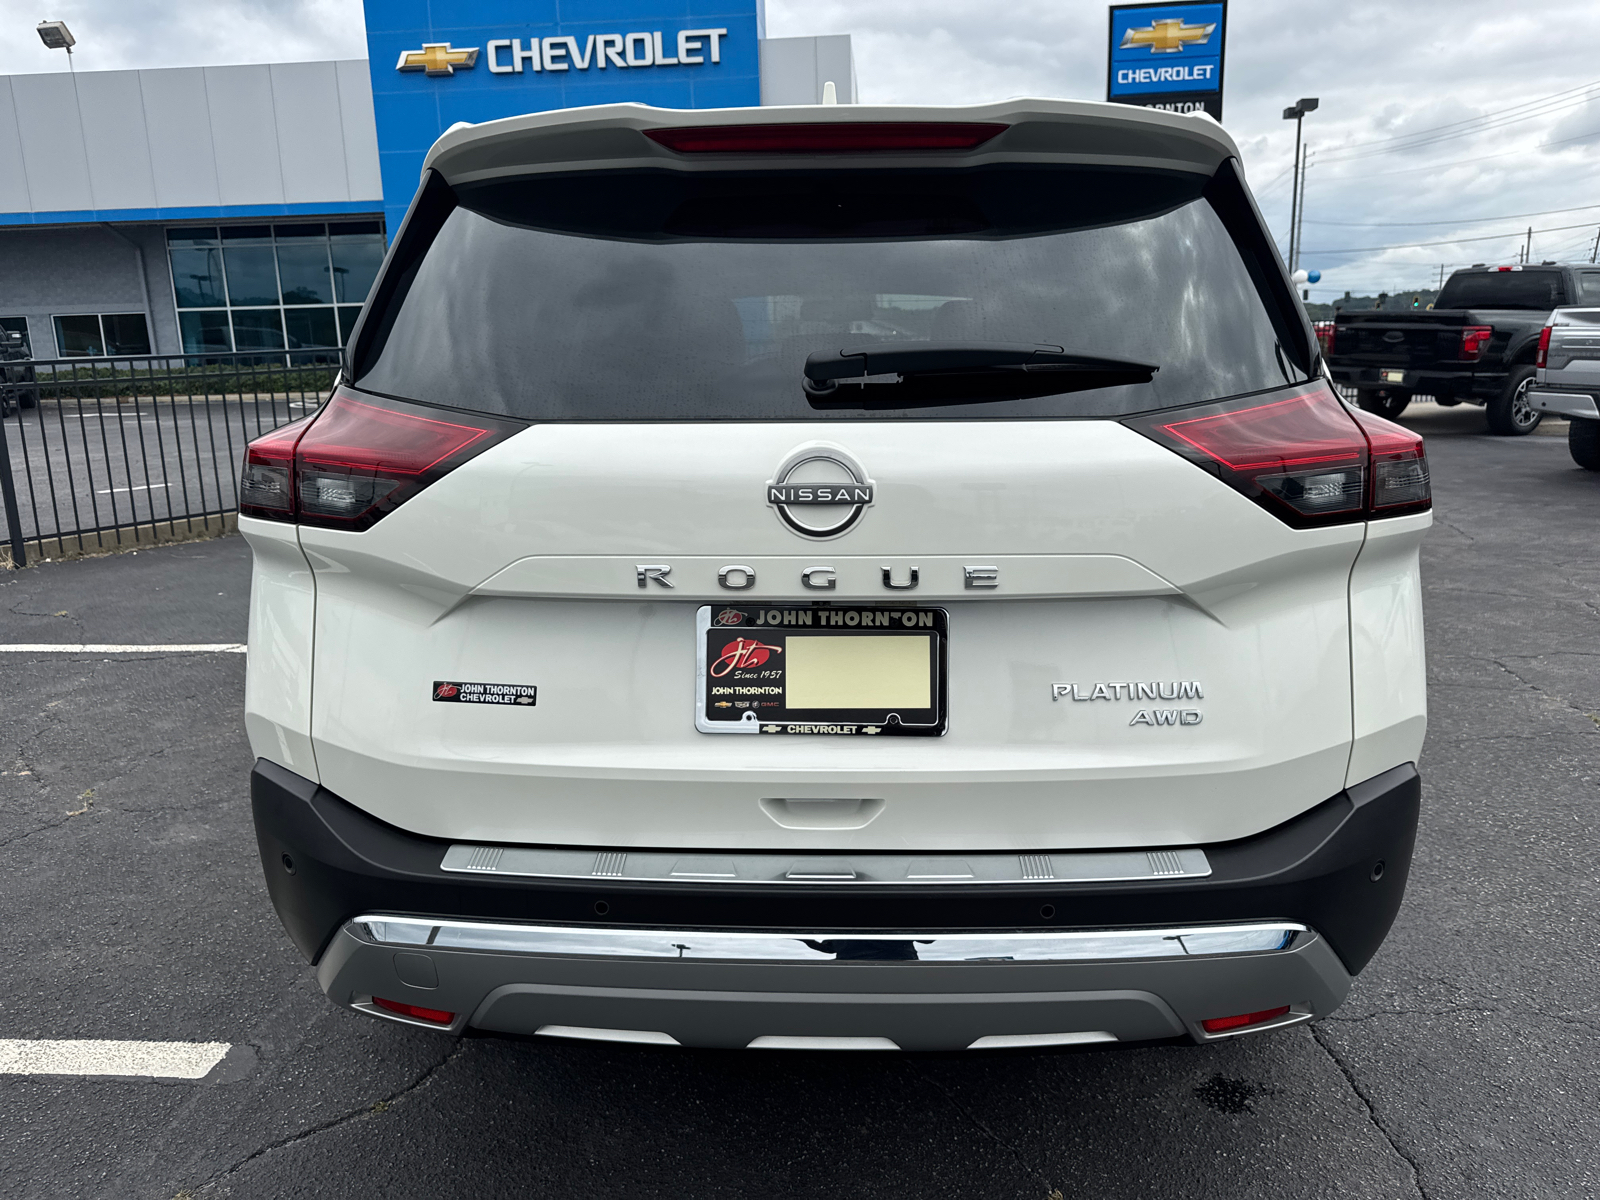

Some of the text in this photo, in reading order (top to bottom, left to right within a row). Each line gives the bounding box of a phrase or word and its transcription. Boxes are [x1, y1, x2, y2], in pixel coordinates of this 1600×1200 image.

[487, 28, 728, 73] CHEVROLET
[1117, 65, 1214, 84] CHEVROLET
[771, 488, 870, 501] NISSAN
[635, 564, 999, 590] ROGUE
[756, 610, 812, 625] JOHN
[734, 670, 782, 679] Since 1957
[461, 684, 484, 693] JOHN
[485, 685, 535, 696] THORNTON
[712, 686, 783, 695] JOHN THORNTON
[1052, 681, 1204, 701] PLATINUM
[460, 693, 516, 704] CHEVROLET
[1129, 709, 1203, 726] AWD
[787, 724, 858, 734] CHEVROLET
